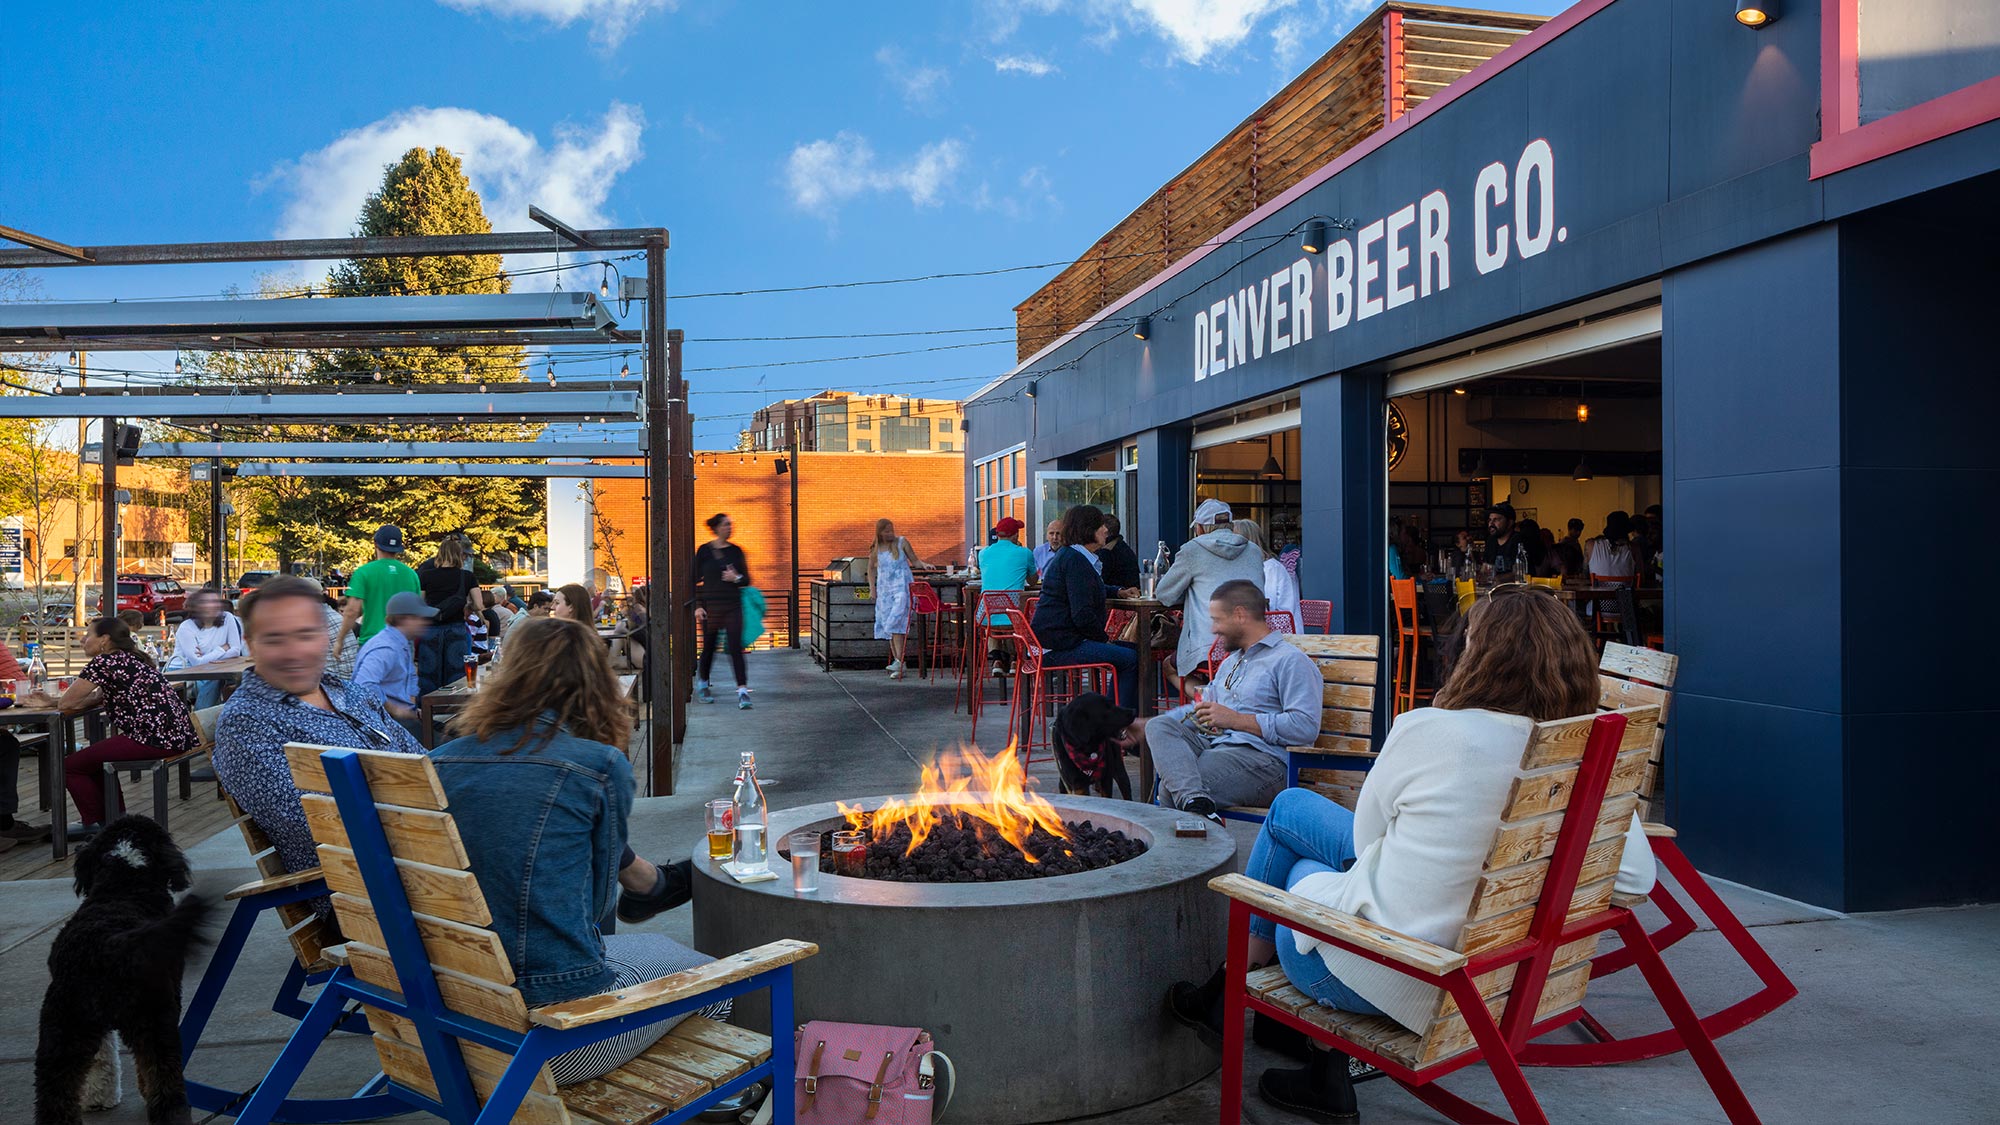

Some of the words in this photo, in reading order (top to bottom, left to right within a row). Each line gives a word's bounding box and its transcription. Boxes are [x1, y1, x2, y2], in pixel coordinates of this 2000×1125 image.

[1194, 257, 1313, 382] DENVER
[1328, 189, 1451, 332] BEER
[1474, 138, 1568, 275] CO.
